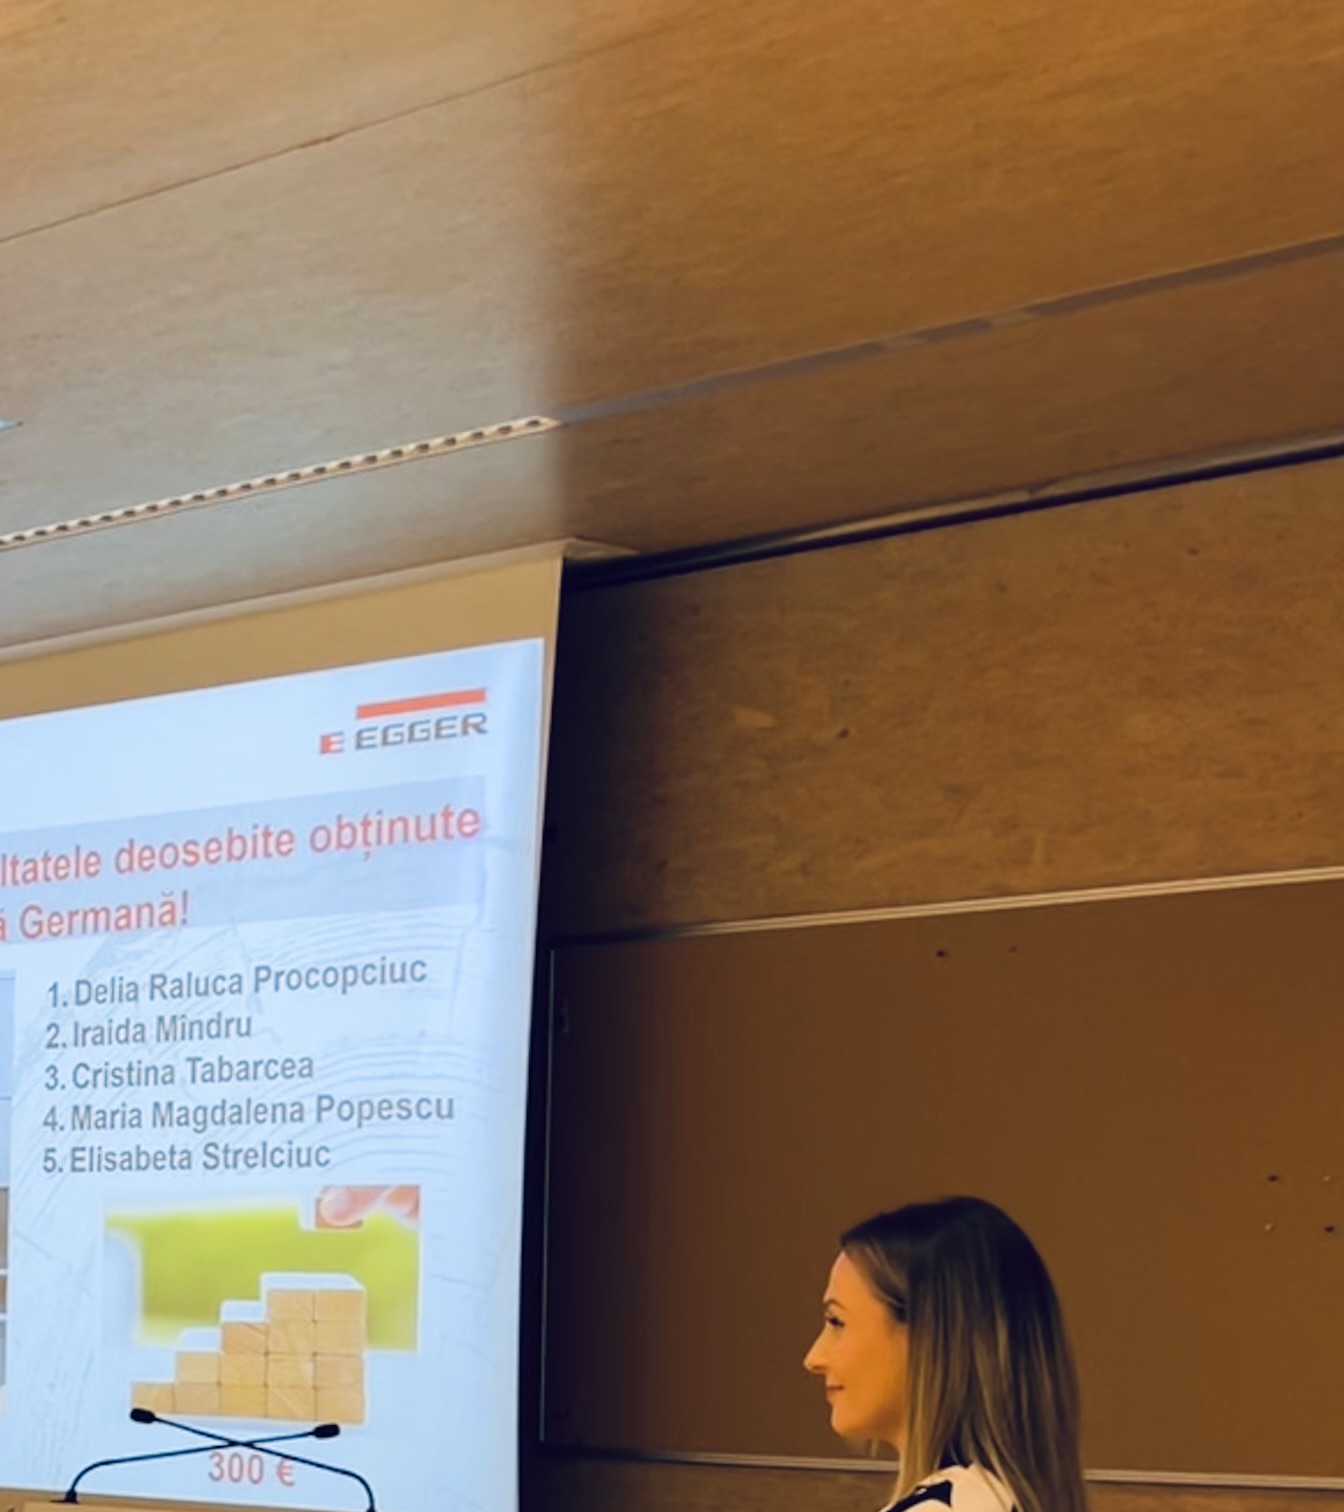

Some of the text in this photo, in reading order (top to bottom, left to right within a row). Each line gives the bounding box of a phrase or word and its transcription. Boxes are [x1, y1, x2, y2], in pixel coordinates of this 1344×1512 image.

[356, 712, 488, 750] EGGER
[116, 823, 295, 875] deosebite
[310, 804, 481, 860] obținute
[20, 890, 189, 940] Germană!
[48, 956, 428, 1008] 1. Delia Raluca Procopciuc
[45, 1012, 252, 1049] 2. Iraida Mîndru
[44, 1055, 313, 1090] 3. Cristina Tabarcea
[43, 1094, 455, 1134] 4. Maria Magdalena Popescu
[43, 1140, 331, 1173] 5. Elisabeta Strelciuc
[208, 1451, 295, 1486] 300 €
